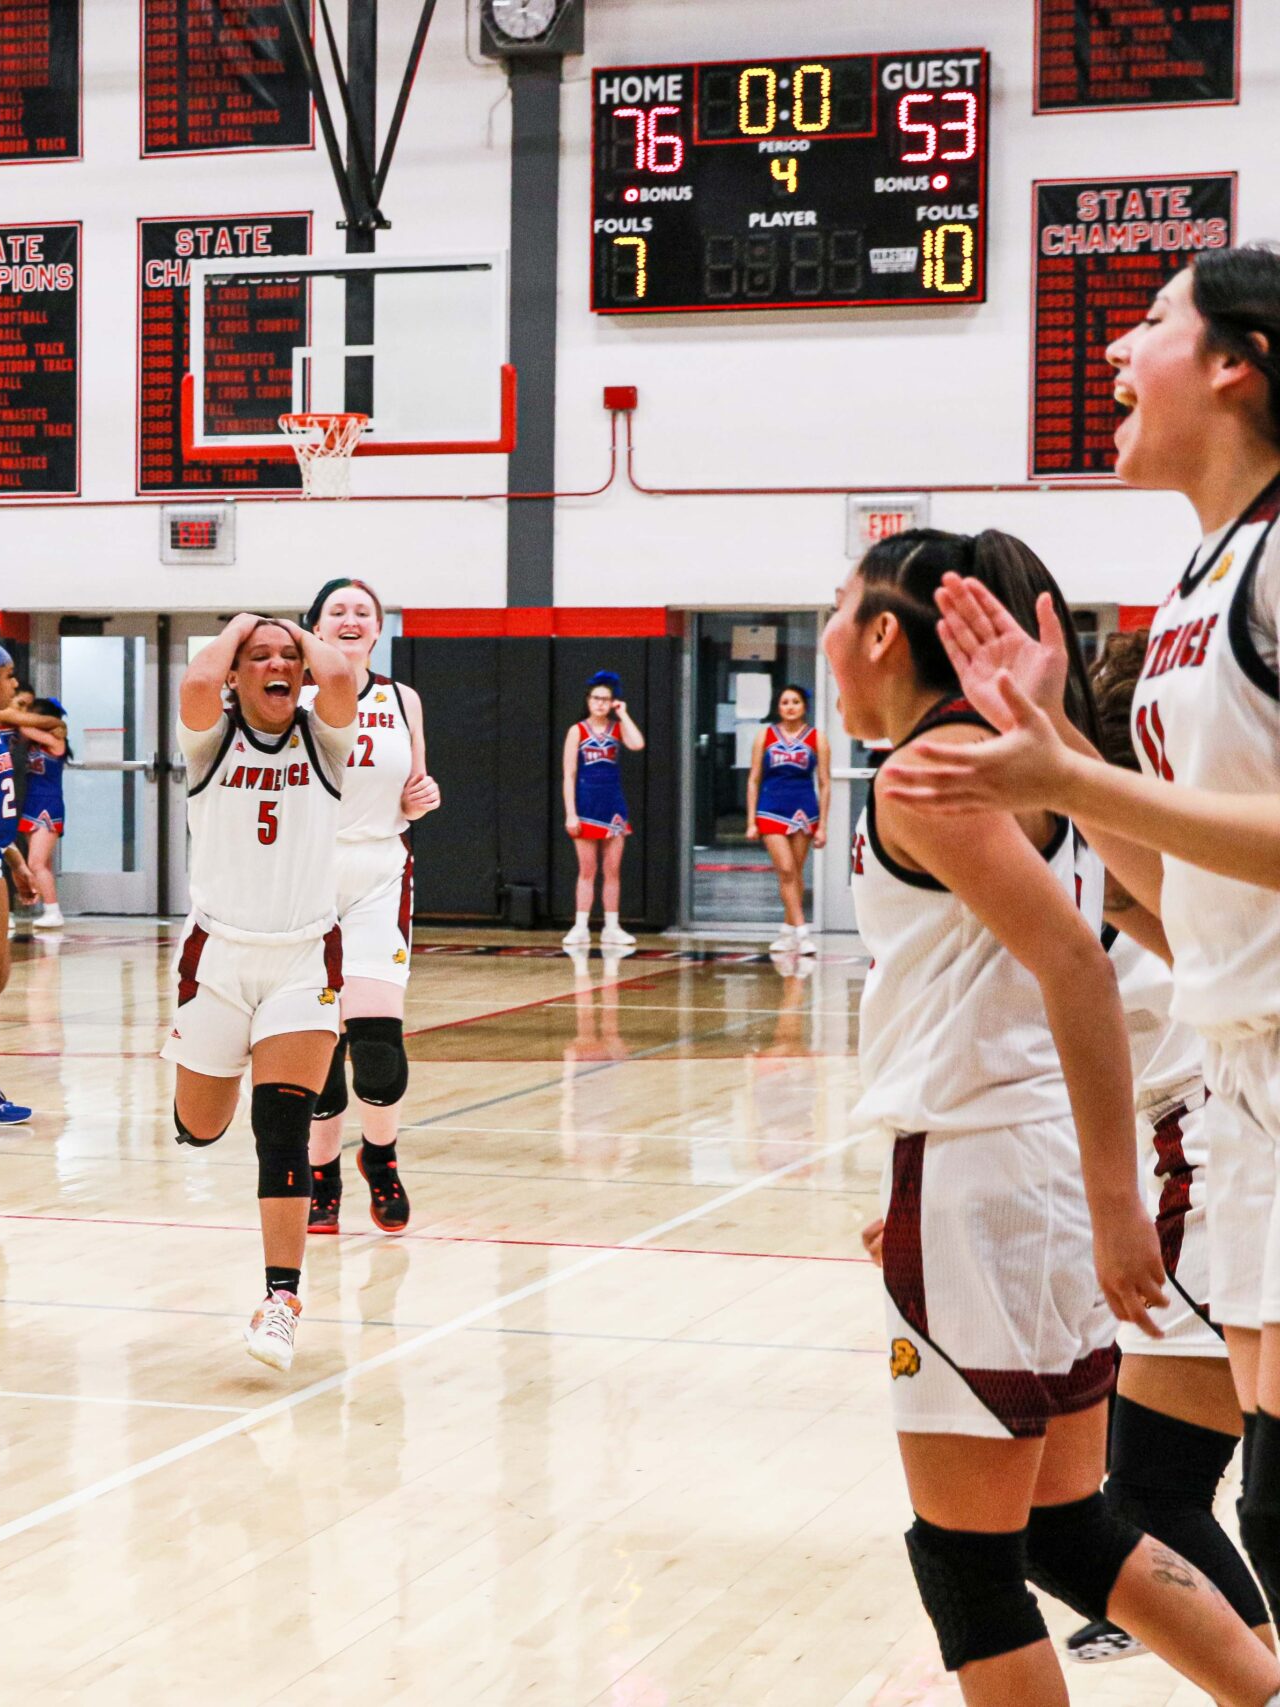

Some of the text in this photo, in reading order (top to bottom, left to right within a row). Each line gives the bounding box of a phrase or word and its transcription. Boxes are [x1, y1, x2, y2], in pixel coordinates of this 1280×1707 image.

[882, 58, 980, 91] GUEST
[600, 75, 682, 105] HOME
[612, 107, 683, 172] 76
[898, 92, 977, 162] 53
[758, 140, 810, 153] PERIOD
[770, 158, 797, 193] 4
[875, 176, 929, 192] BONUS
[640, 186, 692, 202] BONUS
[1077, 186, 1192, 222] STATE
[594, 218, 652, 234] FOULS
[749, 211, 817, 228] PLAYER
[917, 204, 978, 222] FOULS
[175, 224, 272, 256] STATE
[1041, 217, 1228, 256] CHAMPIONS
[613, 236, 647, 298] 7
[923, 224, 973, 292] 10
[35, 343, 65, 355] TRACK
[43, 359, 74, 371] TRACK
[44, 423, 73, 436] TRACK
[868, 513, 904, 540] EXIT
[257, 800, 278, 845] 5
